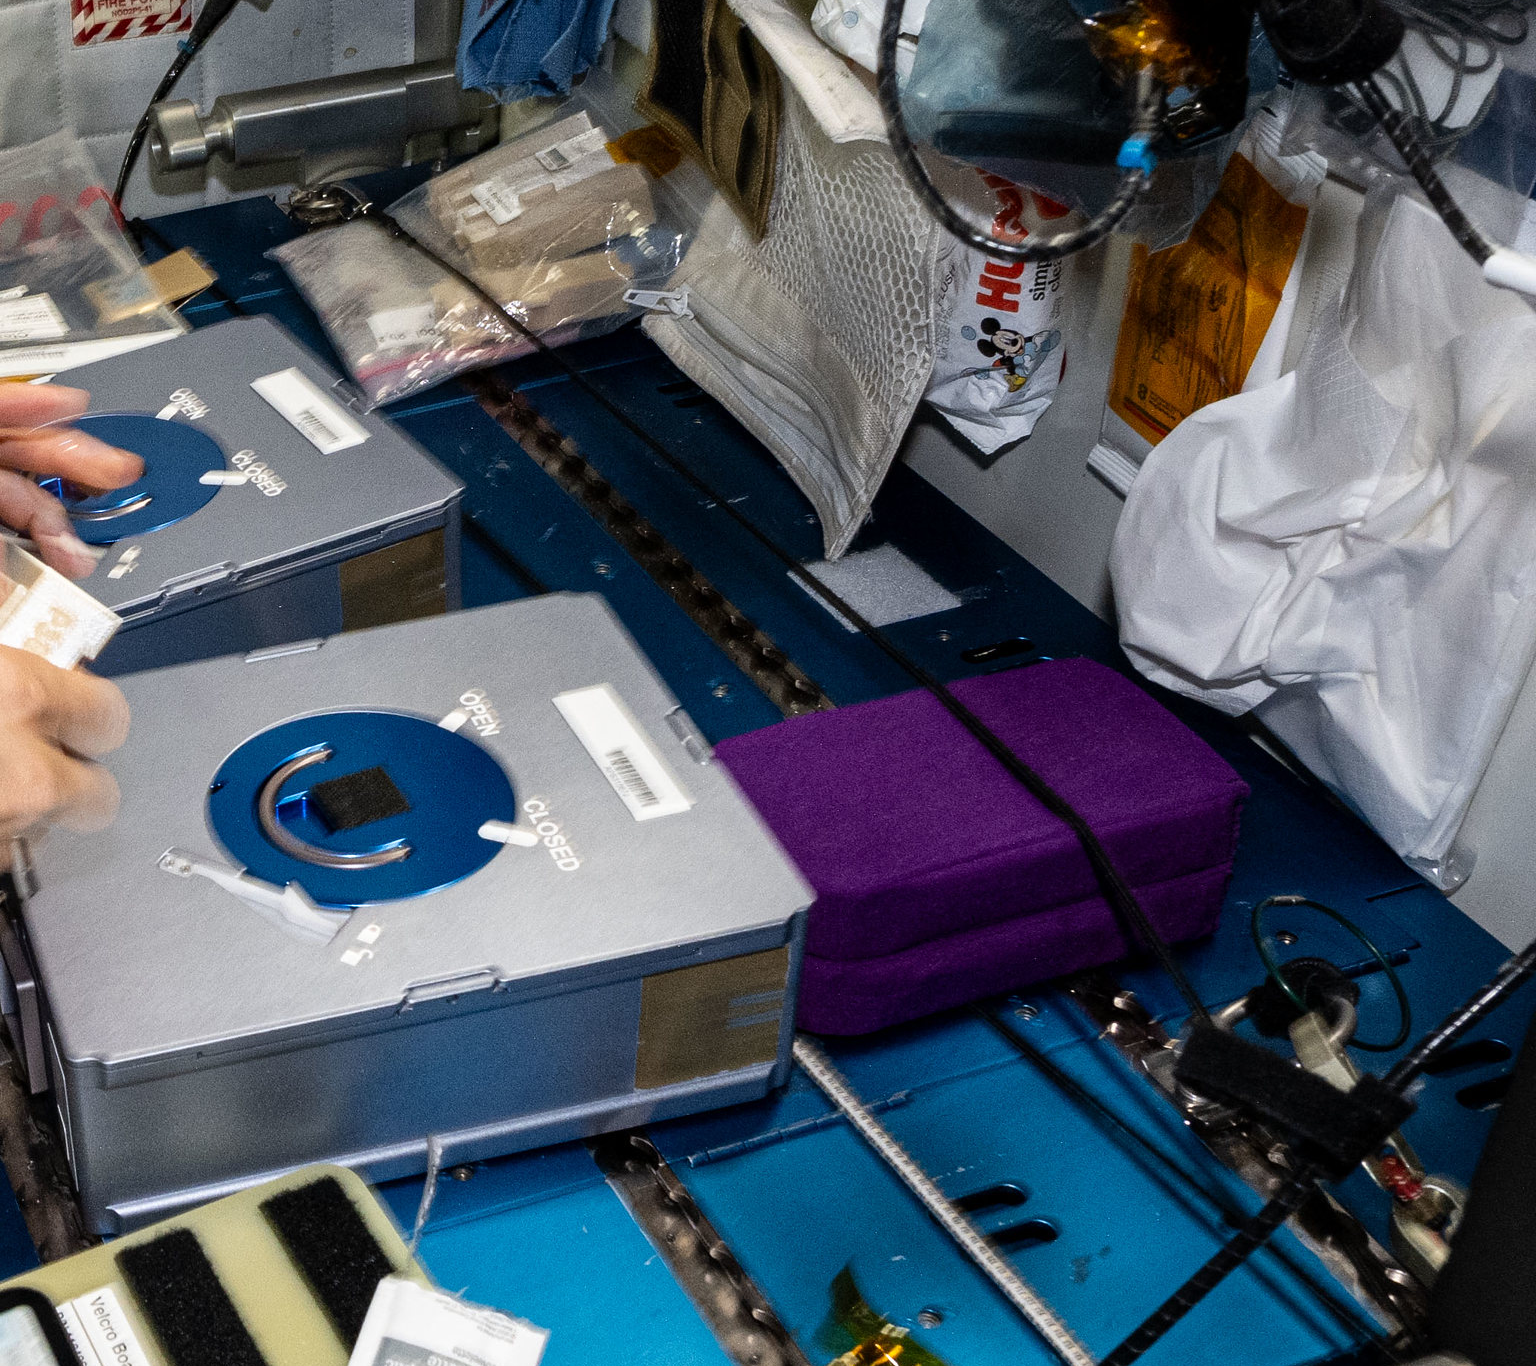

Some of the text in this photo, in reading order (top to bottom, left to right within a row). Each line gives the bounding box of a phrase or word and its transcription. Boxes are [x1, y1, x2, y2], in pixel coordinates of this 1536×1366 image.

[169, 388, 210, 421] OPEN
[231, 450, 288, 497] CLOSED
[459, 690, 501, 737] OPEN
[523, 798, 581, 872] CLOSED
[89, 1295, 119, 1342] Velcro
